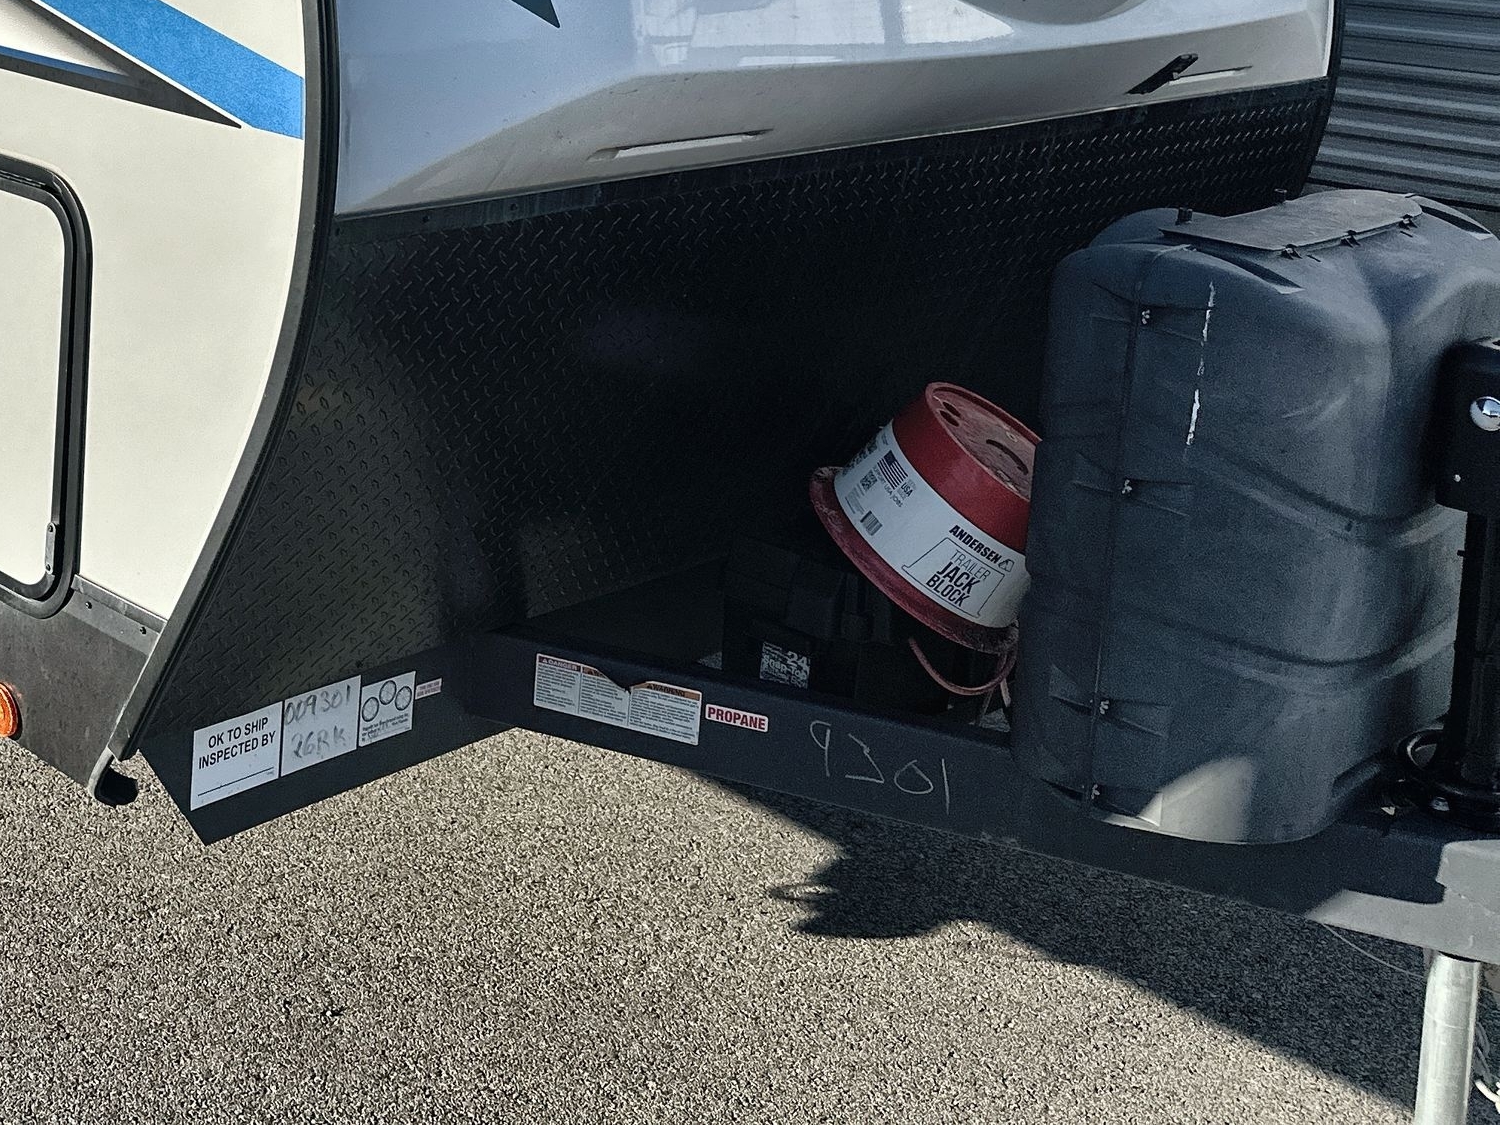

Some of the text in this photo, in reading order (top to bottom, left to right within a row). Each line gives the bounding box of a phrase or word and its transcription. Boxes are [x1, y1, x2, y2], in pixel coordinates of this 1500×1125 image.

[900, 482, 913, 497] USA
[948, 525, 1002, 564] ANDERSEN
[936, 561, 980, 594] JACK
[950, 549, 991, 581] TRAILER
[926, 573, 970, 607] BLOCK
[548, 659, 578, 672] DANGER
[208, 716, 269, 749] OK TO SHIP
[707, 707, 766, 731] PROPANE
[198, 730, 276, 770] INSPECTED BY
